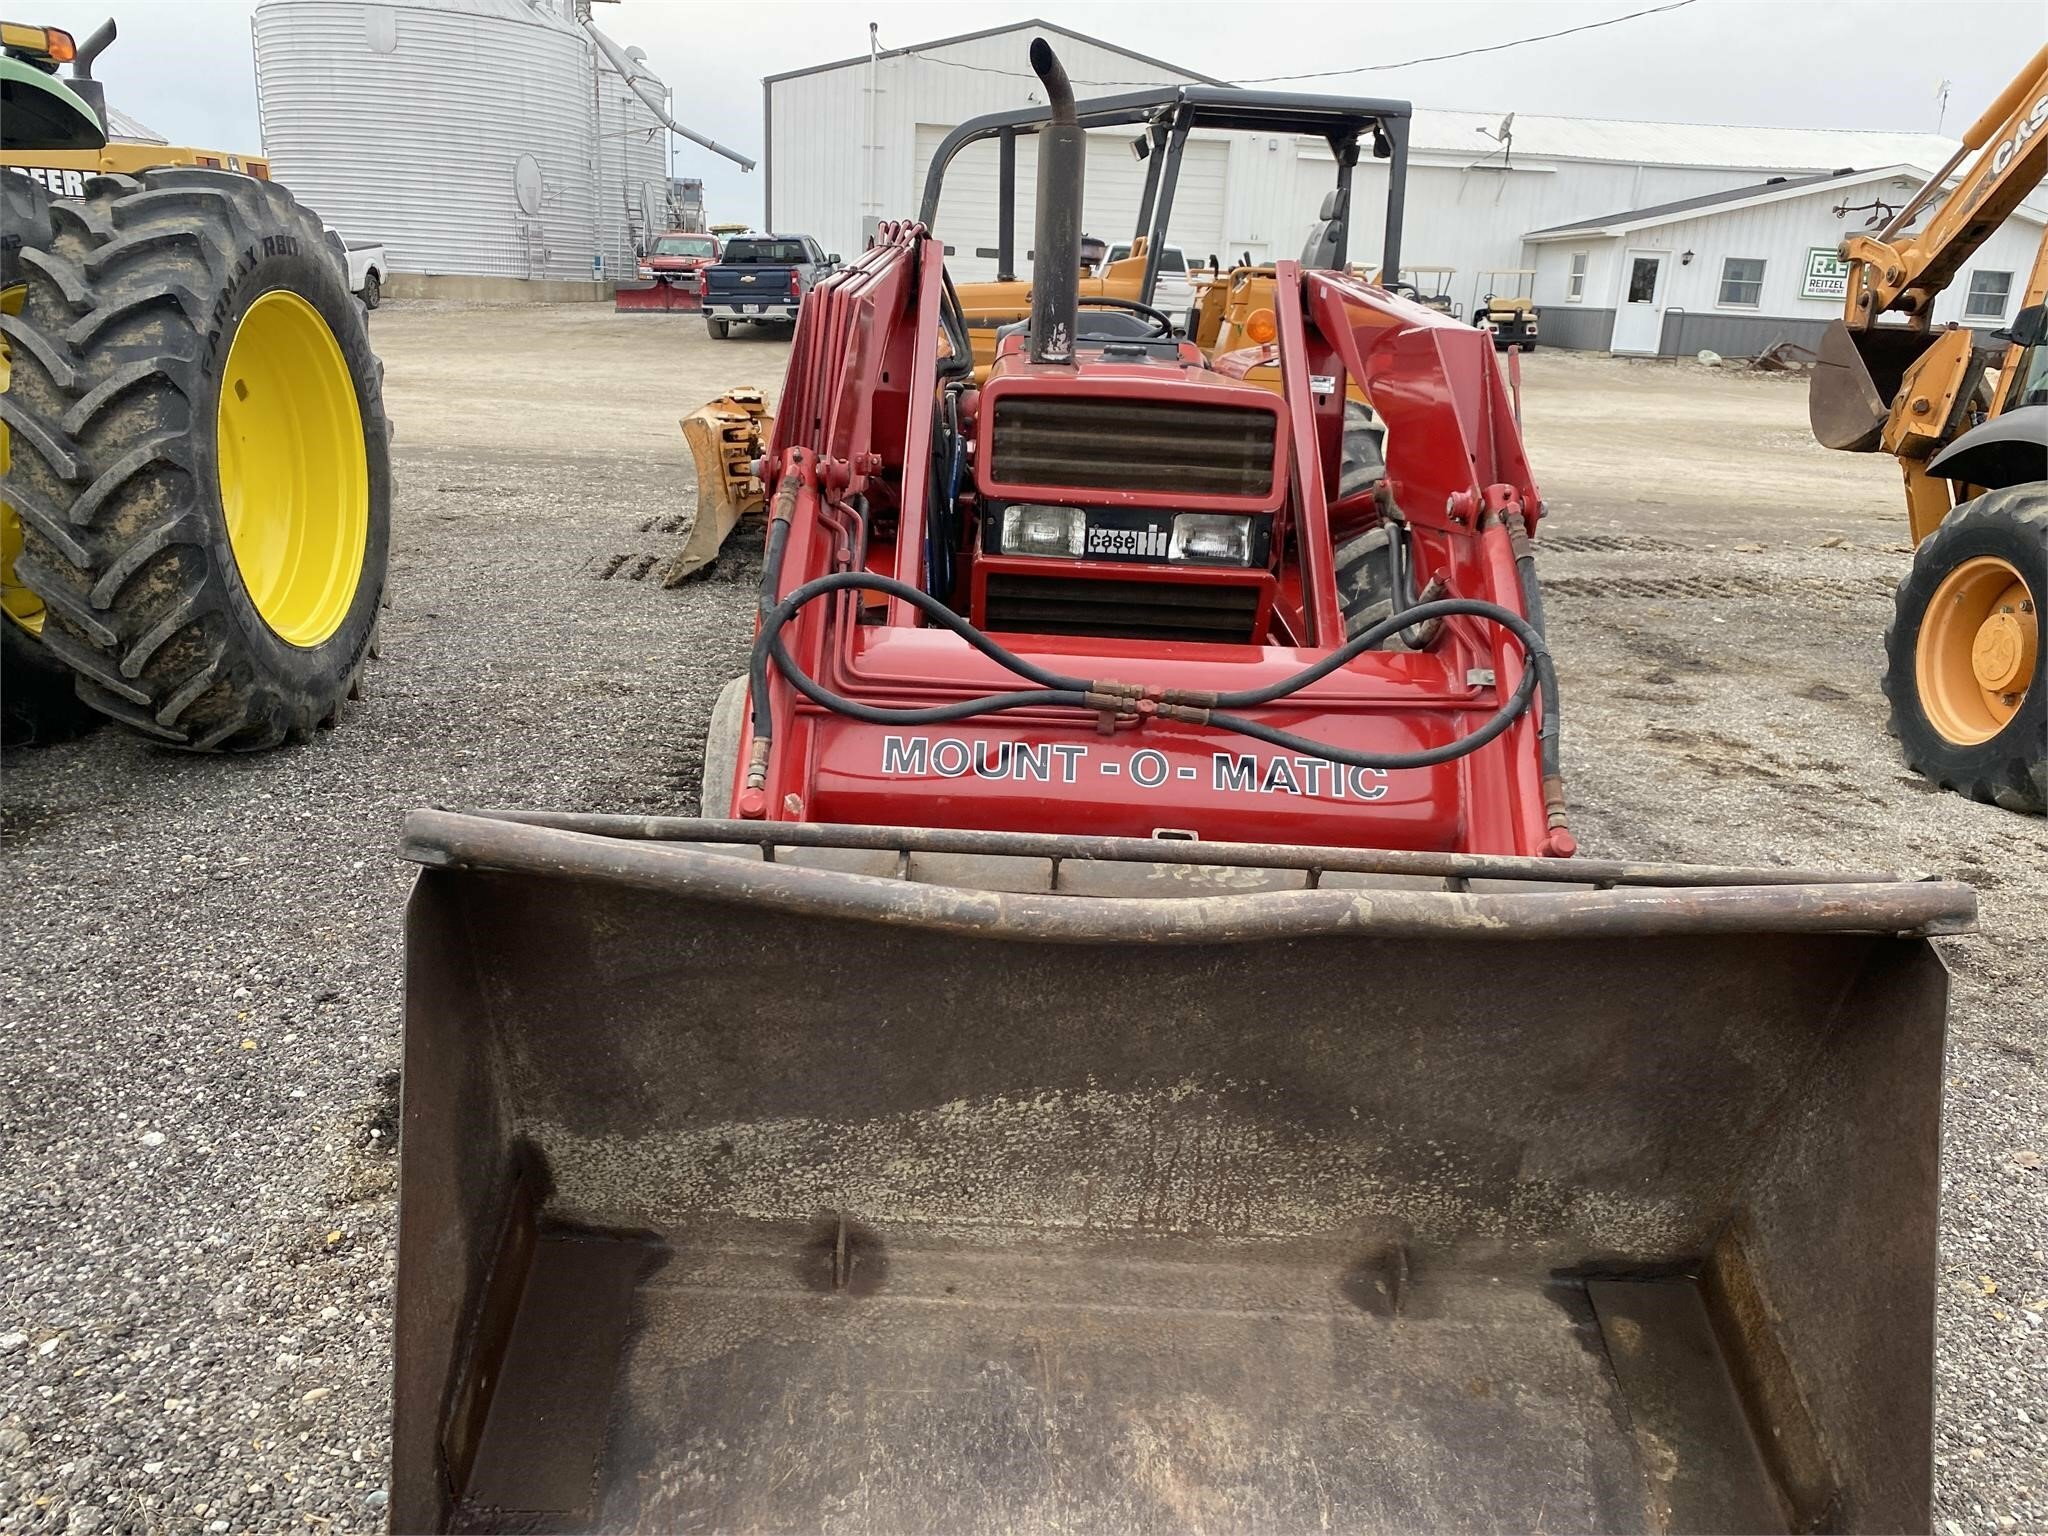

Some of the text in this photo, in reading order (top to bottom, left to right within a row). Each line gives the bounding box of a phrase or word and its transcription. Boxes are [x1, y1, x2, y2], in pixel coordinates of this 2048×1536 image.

[1809, 279, 1845, 289] REITZEL
[882, 735, 1087, 783] MOUNT
[1212, 752, 1389, 801] MATIC
